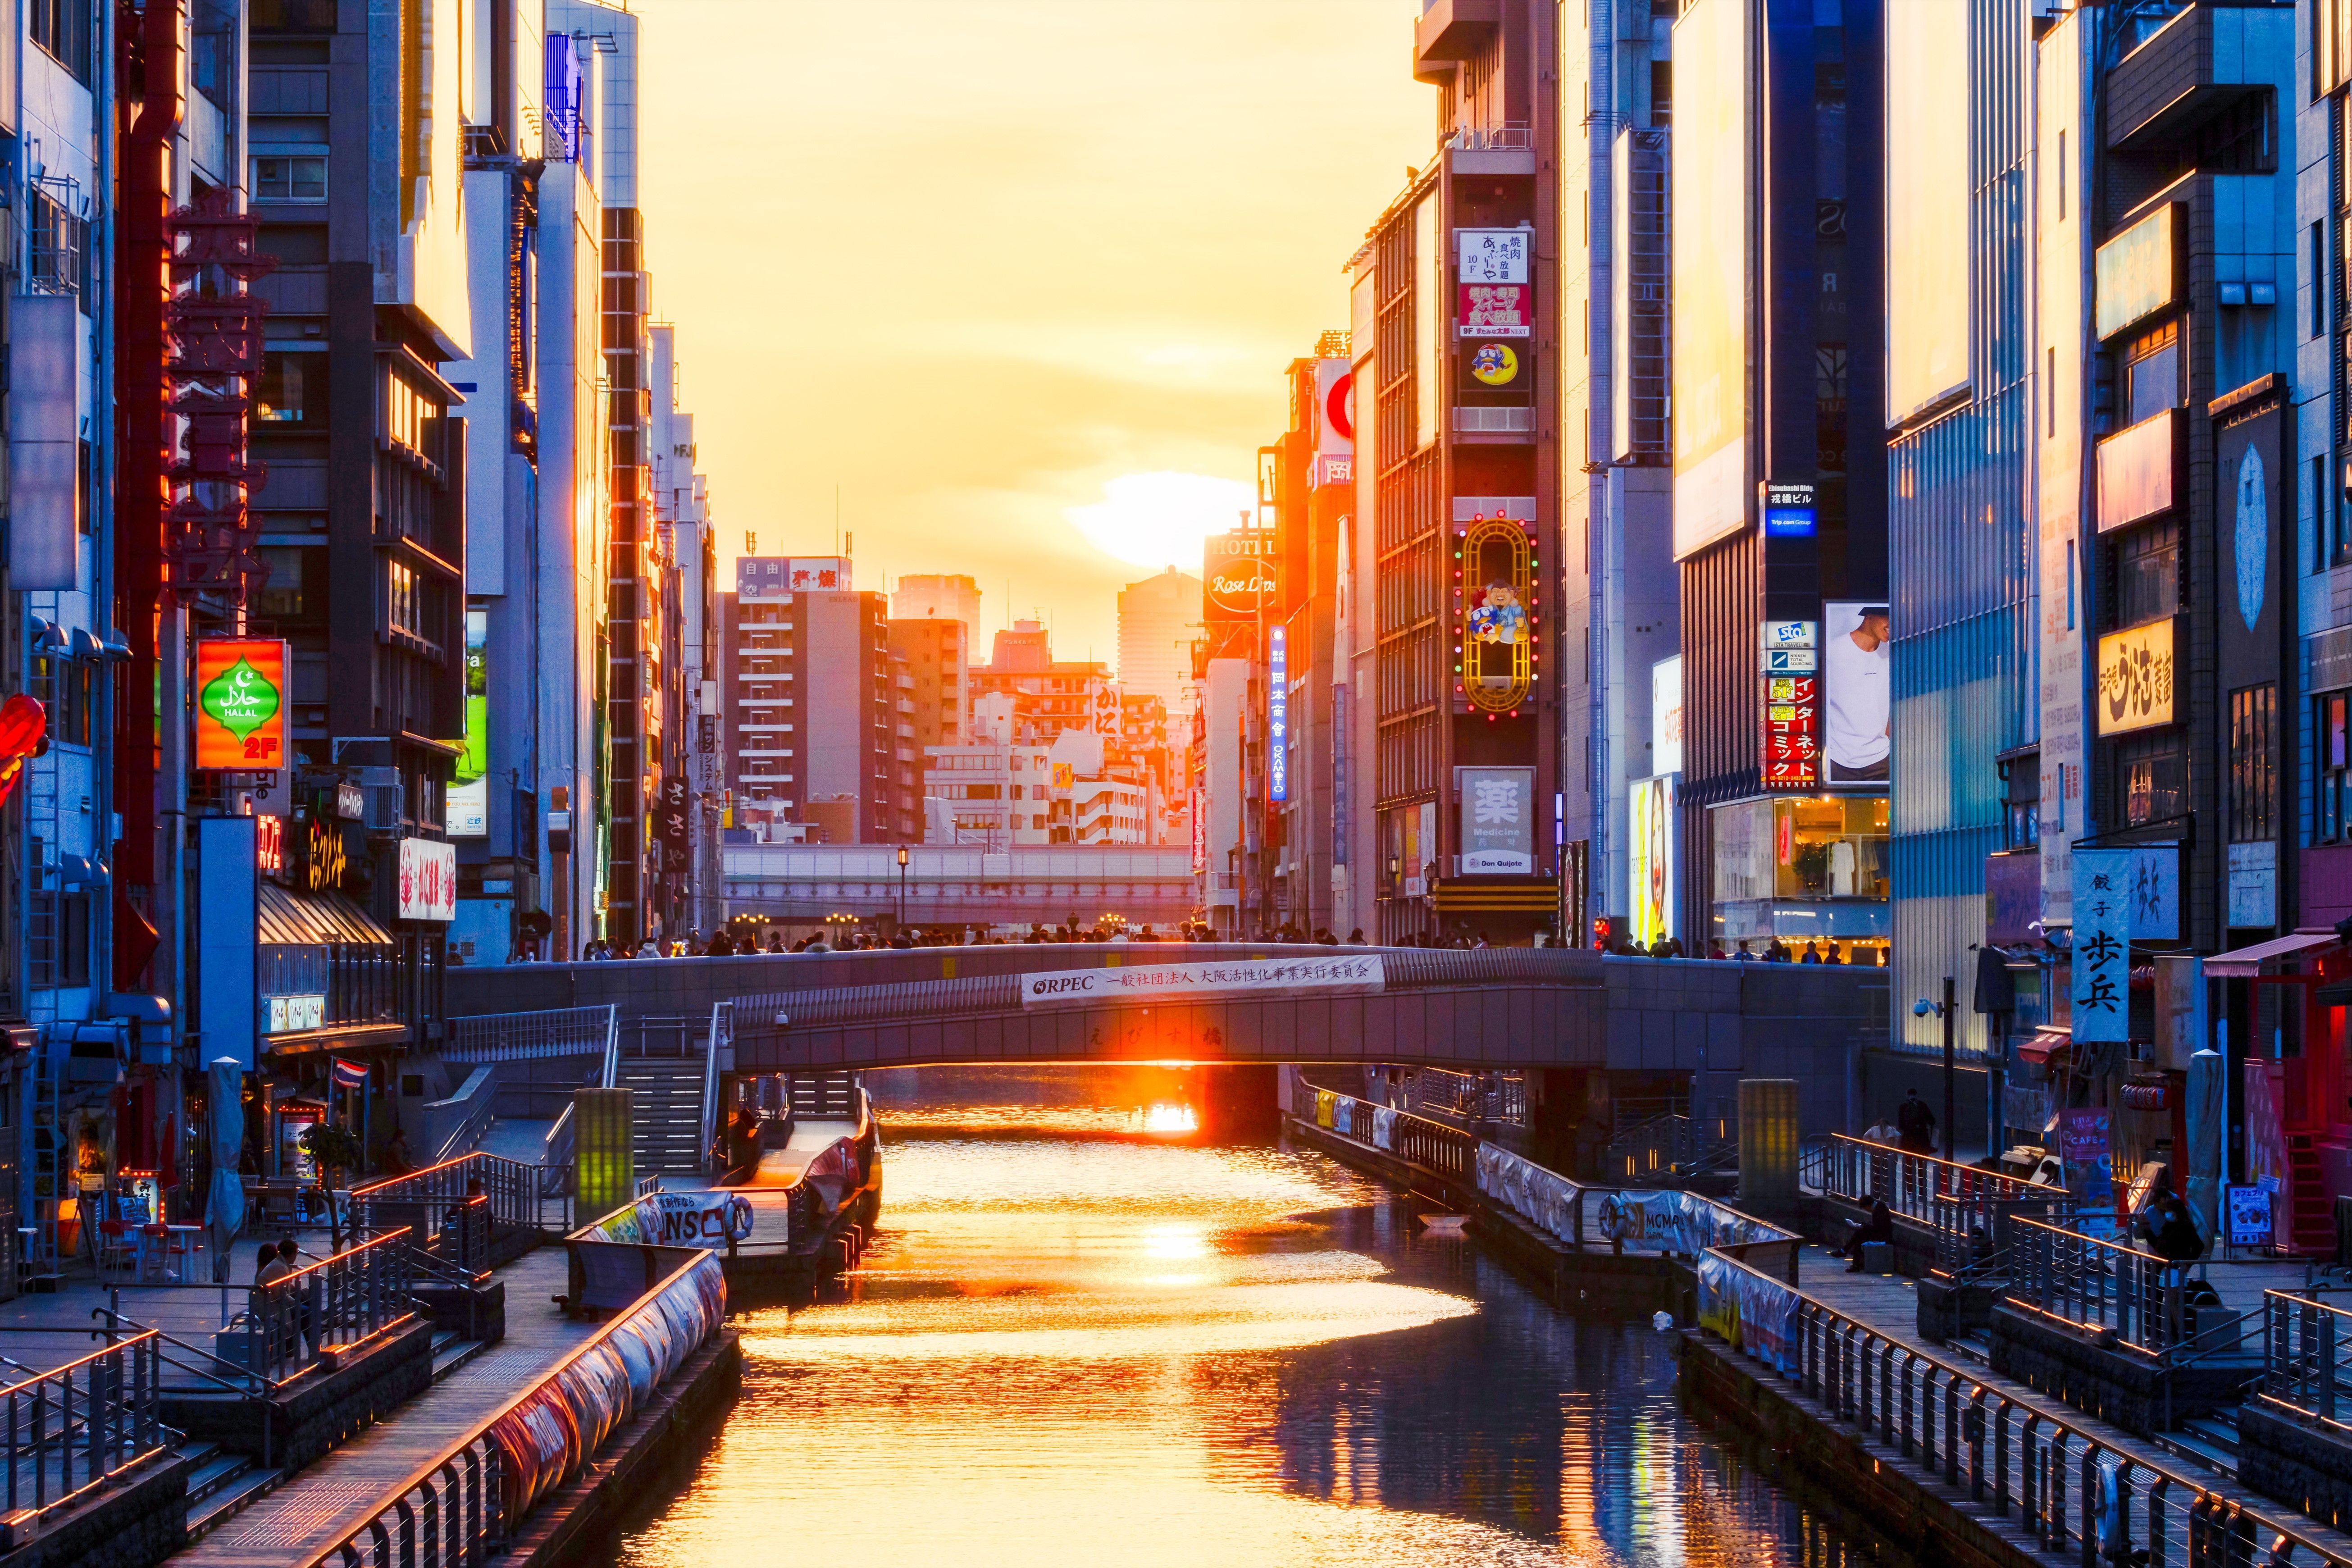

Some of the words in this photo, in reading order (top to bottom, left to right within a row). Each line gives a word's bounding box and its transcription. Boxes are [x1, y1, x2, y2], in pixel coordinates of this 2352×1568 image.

[1468, 255, 1477, 263] 10
[1510, 236, 1521, 260] 焼肉
[1500, 243, 1509, 279] 食べ放題
[1473, 298, 1516, 311] スイーツ
[1468, 310, 1521, 325] 食べ放題
[1771, 494, 1811, 503] 戎橋ビル
[1212, 575, 1245, 594] Rose
[1781, 625, 1802, 638] sta
[220, 684, 260, 707] حلال
[1772, 685, 1793, 698] 5F
[1095, 686, 1117, 734] かに
[1796, 678, 1815, 776] インターネット
[244, 737, 277, 759] 2F
[1773, 721, 1792, 776] コミック
[1475, 779, 1518, 823] 薬
[667, 782, 684, 867] ささや
[2089, 874, 2112, 917] 餃子
[1033, 975, 1094, 995] ORPEC
[1106, 971, 1194, 987] 一般社団法人
[1200, 963, 1369, 985] 大阪活性化事業実行委員会
[2077, 930, 2123, 1013] 歩兵
[2071, 1136, 2098, 1144] CAFE
